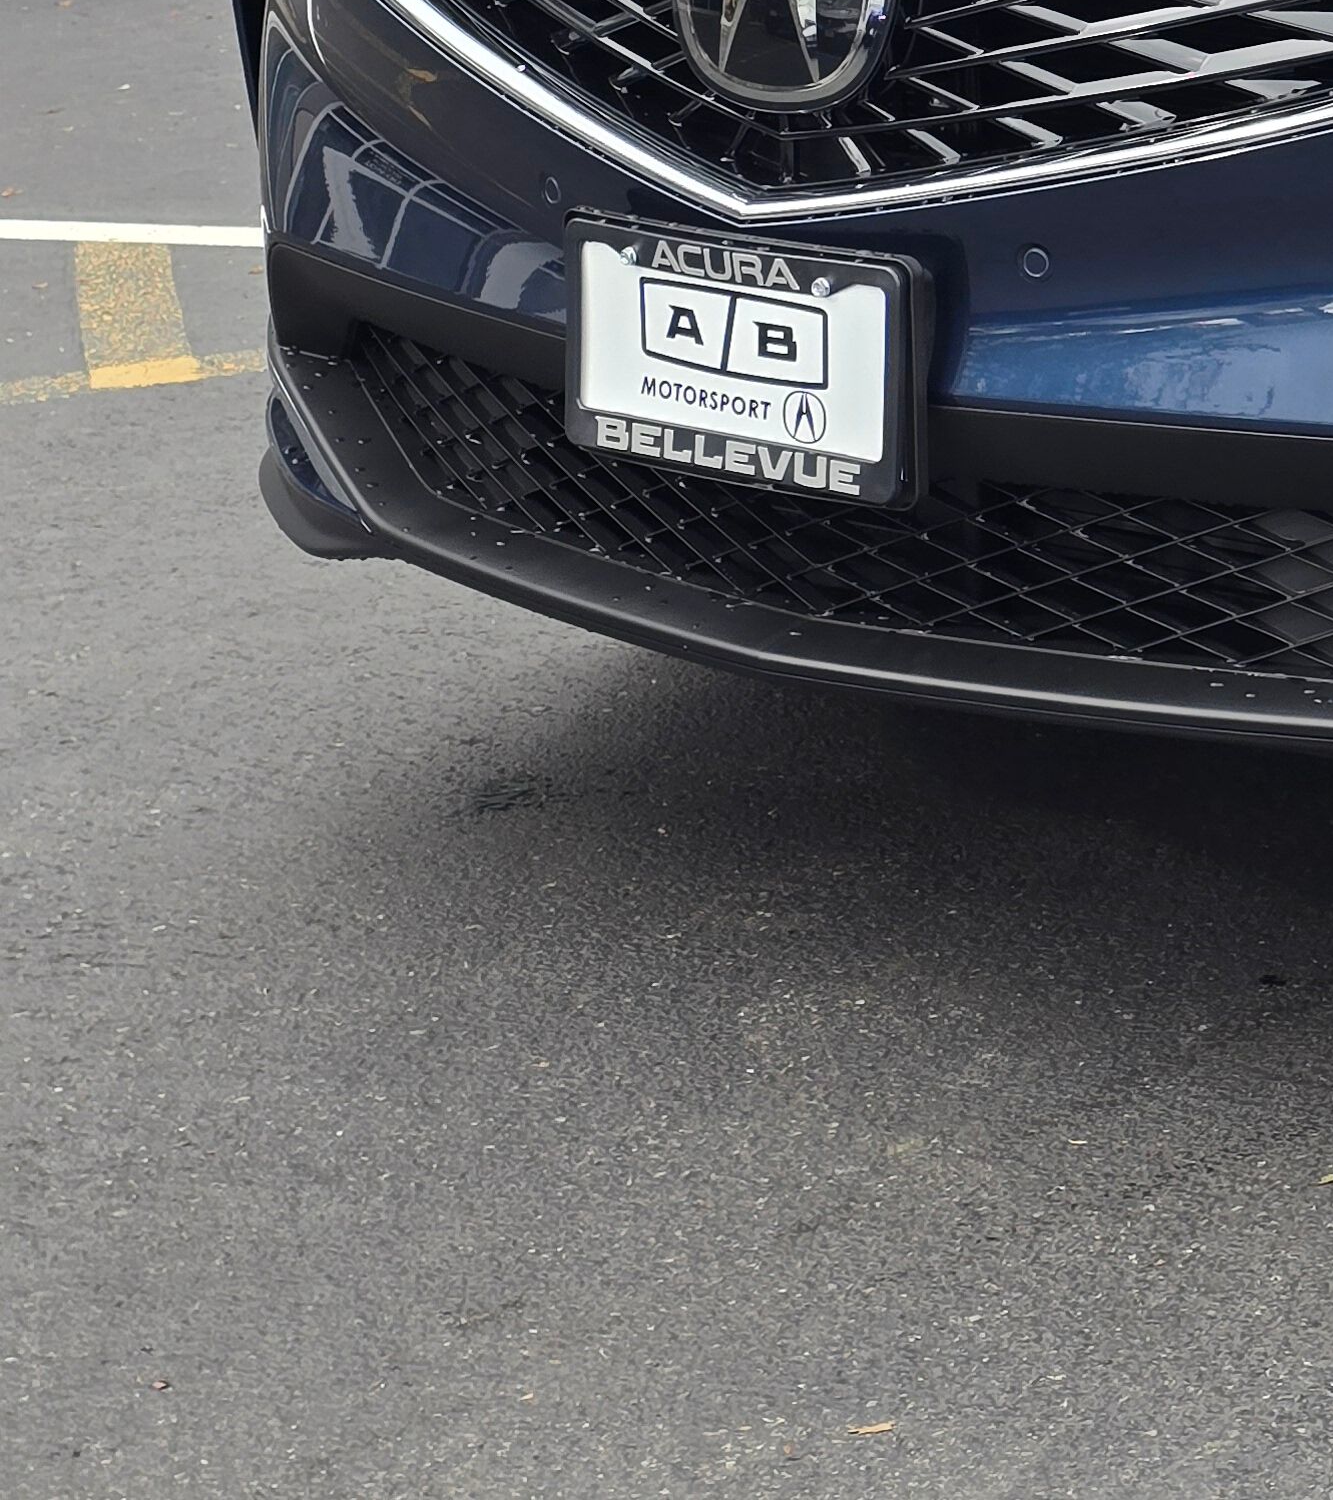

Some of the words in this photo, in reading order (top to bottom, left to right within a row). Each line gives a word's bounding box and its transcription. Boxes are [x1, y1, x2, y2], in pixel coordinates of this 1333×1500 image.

[651, 240, 800, 290] ACURA
[666, 304, 705, 346] A
[752, 321, 797, 362] B
[641, 376, 771, 420] MOTORSPORT
[594, 415, 861, 496] BELLEVUE
